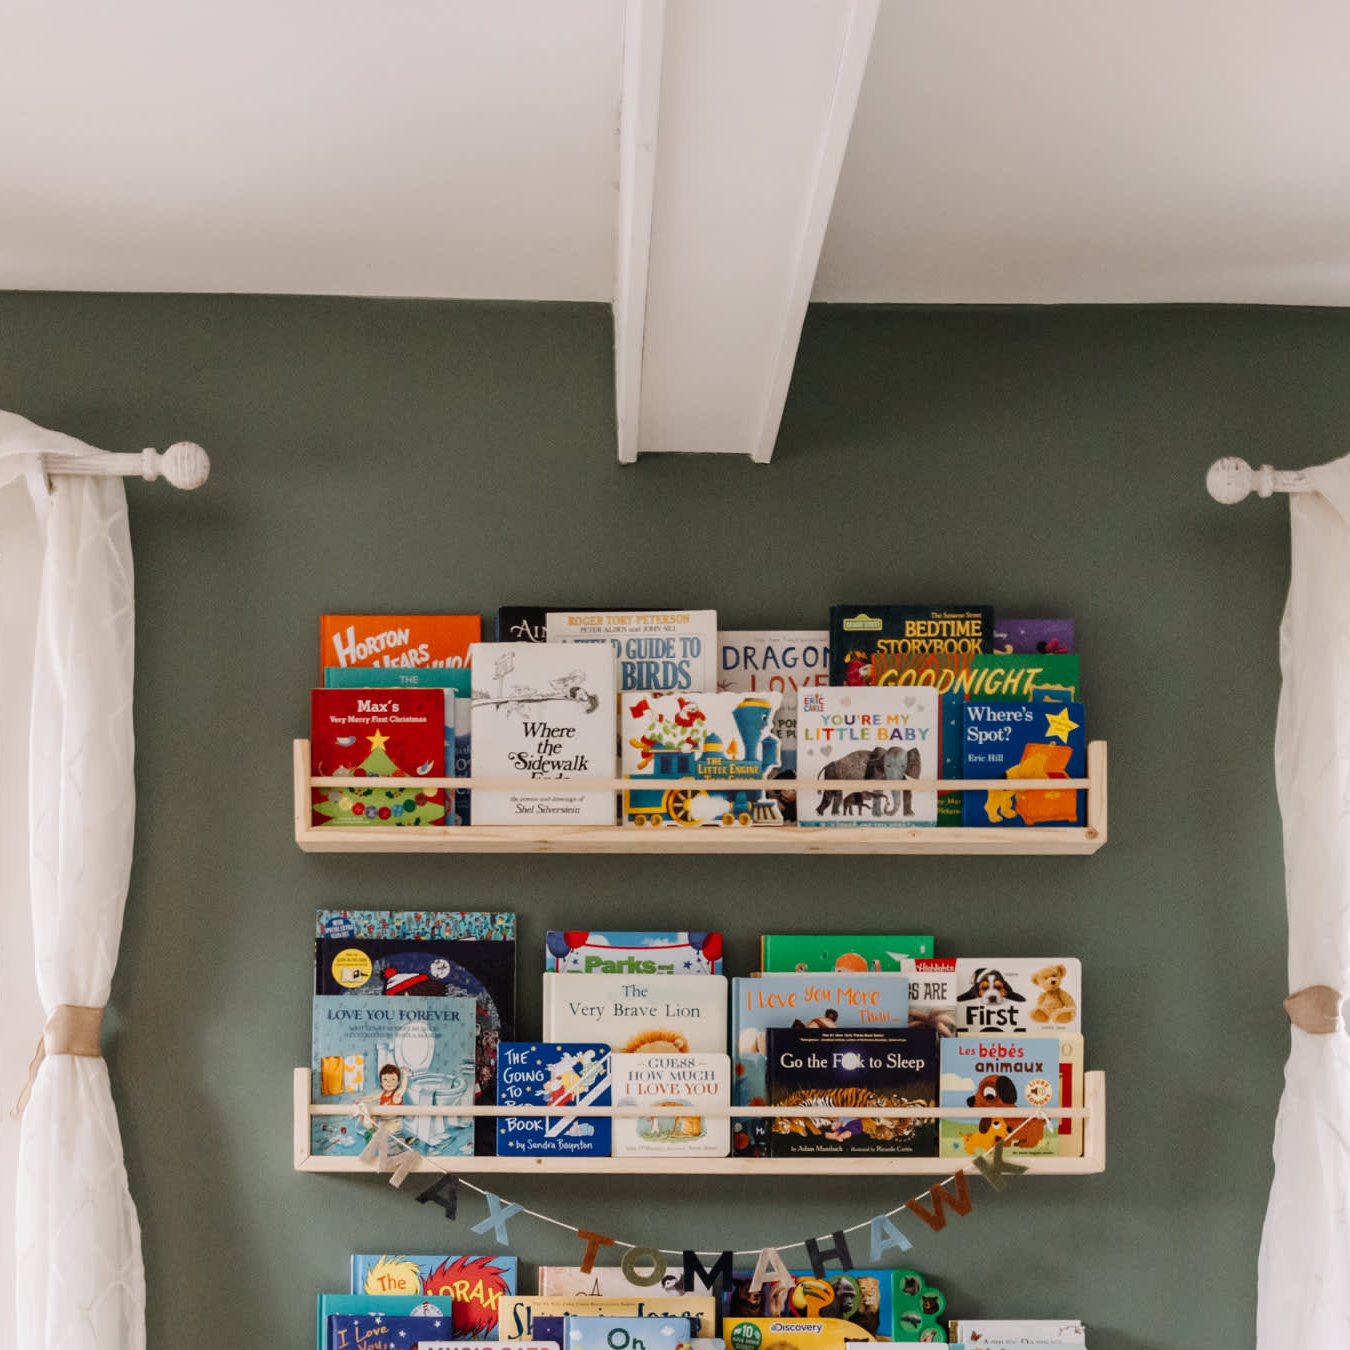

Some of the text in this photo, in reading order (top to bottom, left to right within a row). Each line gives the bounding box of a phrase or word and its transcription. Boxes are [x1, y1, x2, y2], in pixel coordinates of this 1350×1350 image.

[568, 614, 690, 627] ROGER TORY PETERSON
[905, 620, 983, 638] BEDTIME
[332, 625, 410, 668] HORTON
[626, 637, 676, 659] GUIDE
[680, 637, 702, 658] TO
[876, 639, 983, 655] STORYBOOK
[399, 675, 419, 685] THE
[622, 660, 692, 691] BIRDS
[878, 667, 1044, 695] GOODNIGHT
[356, 699, 400, 713] Max's
[966, 706, 1034, 722] Where's
[821, 714, 910, 726] YOU'RE MY
[522, 722, 576, 738] Where
[805, 727, 871, 741] LITTLE
[877, 727, 930, 741] BABY
[966, 726, 1012, 745] Spot?
[537, 739, 563, 756] the
[508, 752, 590, 773] Sidewalk
[706, 757, 723, 766] THE
[967, 753, 1004, 762] Eric Hill
[697, 765, 760, 775] LITTLE ENGINE
[515, 803, 581, 815] Shel Silverstein
[585, 955, 657, 974] Parks
[621, 984, 649, 997] The
[758, 990, 798, 1009] Love
[836, 986, 881, 1006] More
[924, 982, 948, 1001] ARE
[327, 1008, 460, 1021] LOVE YOU FOREVER
[569, 1003, 701, 1021] Very Brave Lion
[966, 1005, 1019, 1026] First
[504, 1049, 530, 1066] THE
[958, 1043, 1025, 1058] Les bébés
[648, 1058, 696, 1068] GUESS
[780, 1052, 803, 1069] Go
[807, 1053, 828, 1068] the
[870, 1056, 882, 1068] to
[886, 1053, 925, 1072] Sleep
[975, 1058, 1044, 1073] animaux
[503, 1067, 545, 1084] GOING
[628, 1071, 715, 1081] HOW MUCH
[506, 1084, 523, 1098] TO
[626, 1083, 719, 1095] I LOVE YOU
[505, 1118, 544, 1132] BOOK
[516, 1138, 593, 1151] by Sandra Boynton
[376, 1273, 407, 1292] The
[743, 1325, 753, 1338] 10
[775, 1322, 823, 1333] Discovery
[338, 1325, 390, 1349] I Love
[607, 1328, 646, 1350] On
